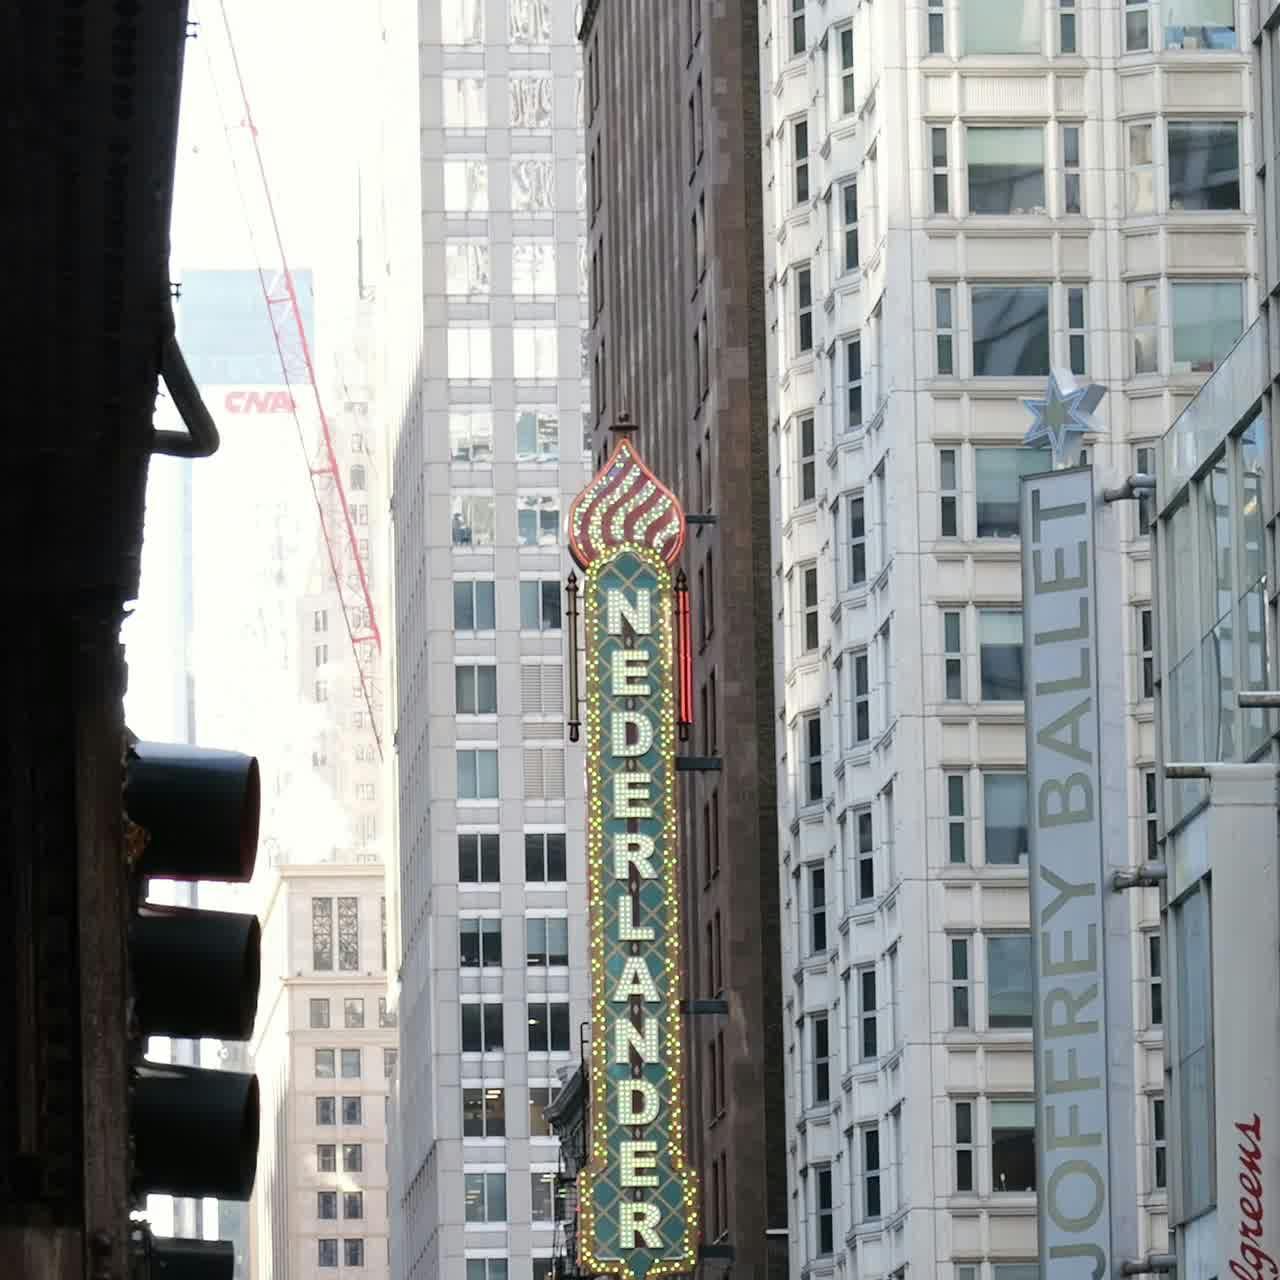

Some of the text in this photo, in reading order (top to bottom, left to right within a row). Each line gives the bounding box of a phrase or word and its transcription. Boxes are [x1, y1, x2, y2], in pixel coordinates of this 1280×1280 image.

[224, 390, 298, 414] CNA
[1031, 488, 1095, 830] BALLET
[606, 588, 662, 1250] NEDERLANDER
